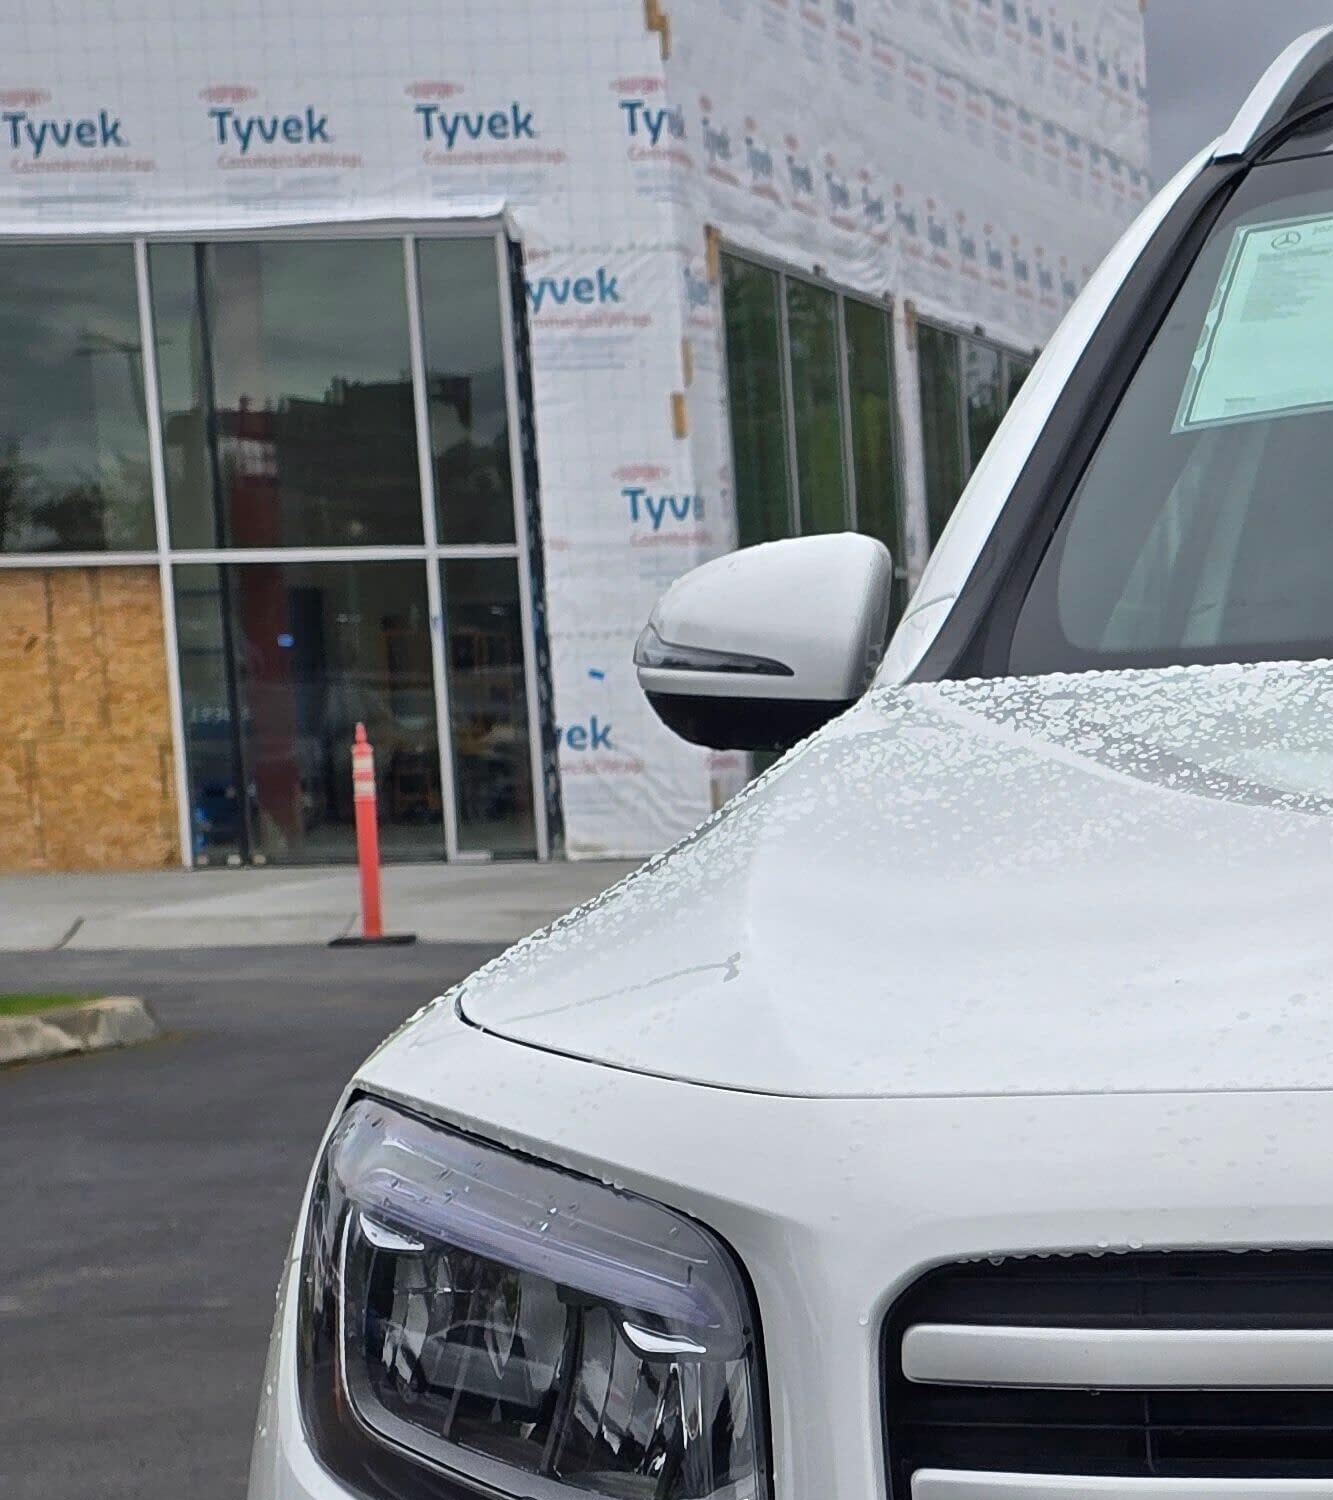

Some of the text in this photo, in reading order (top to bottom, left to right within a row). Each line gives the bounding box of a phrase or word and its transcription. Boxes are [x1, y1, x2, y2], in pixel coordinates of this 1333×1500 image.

[2, 108, 123, 159] Tyvek
[208, 105, 330, 155] Tyvek
[414, 102, 536, 151] Tyvek
[525, 266, 620, 314] yvek
